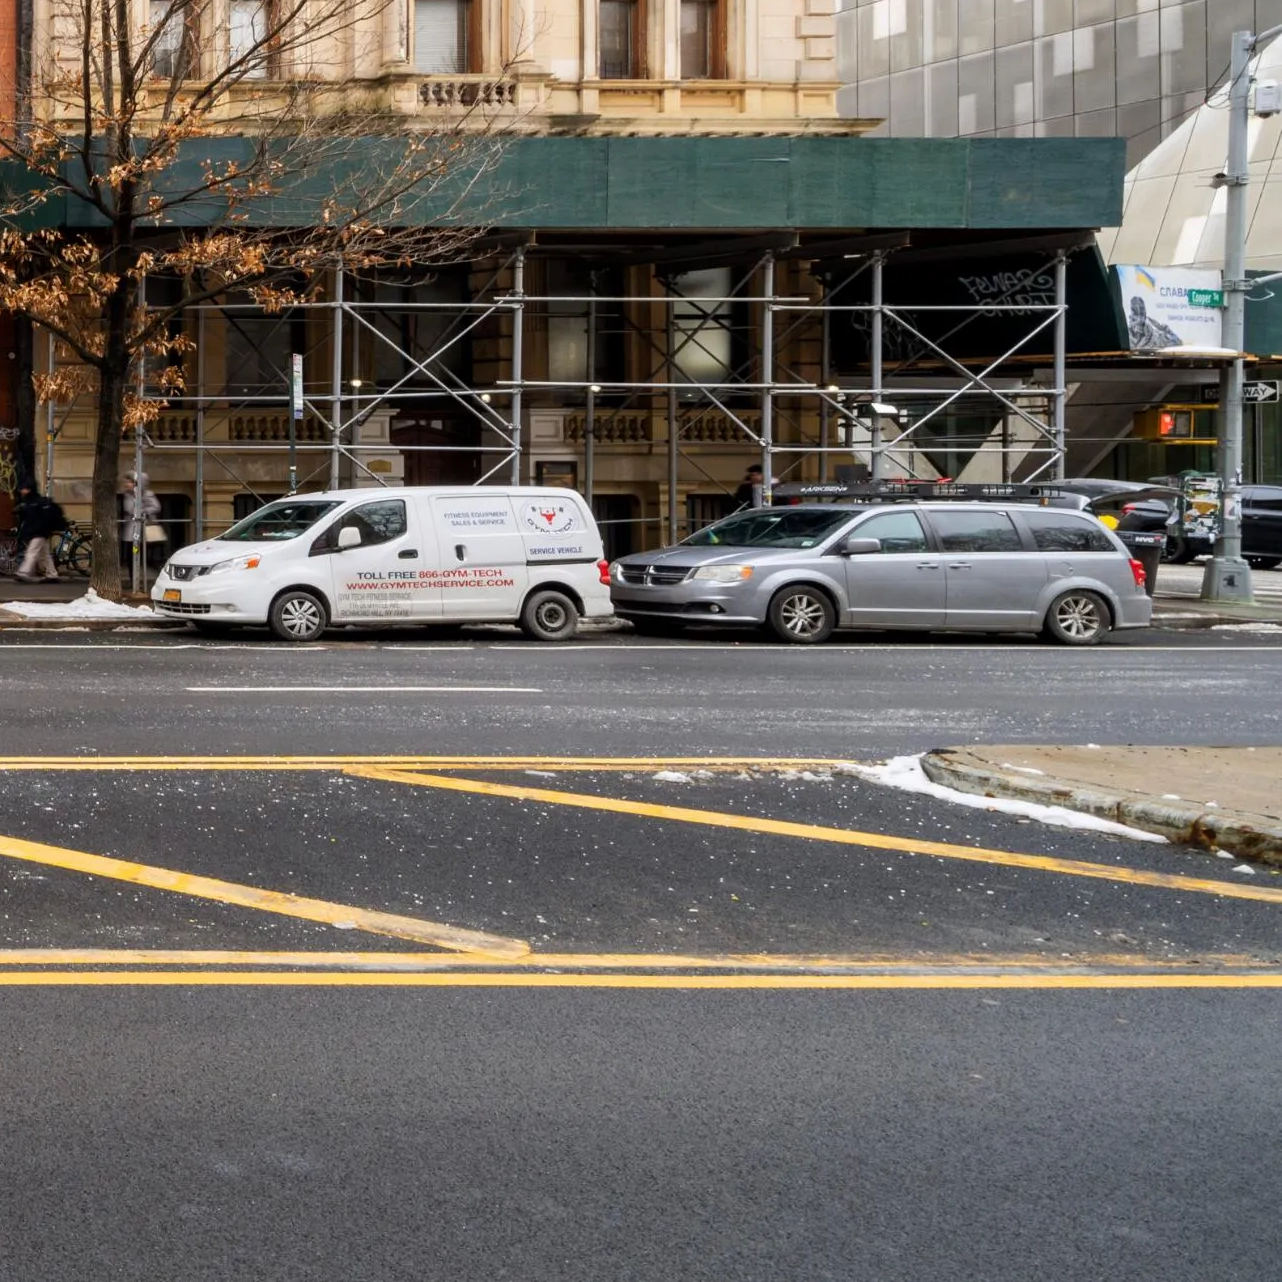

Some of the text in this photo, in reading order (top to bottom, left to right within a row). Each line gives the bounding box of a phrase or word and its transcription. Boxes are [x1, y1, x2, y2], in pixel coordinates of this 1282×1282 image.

[1191, 291, 1212, 305] Cooper
[1243, 387, 1267, 396] WAY
[529, 546, 583, 556] SERVICE VEHICLE
[357, 569, 502, 580] TOLL FREE 866-GYM-TECH
[346, 579, 514, 590] WWW.GYMTECHSERVICE.COM
